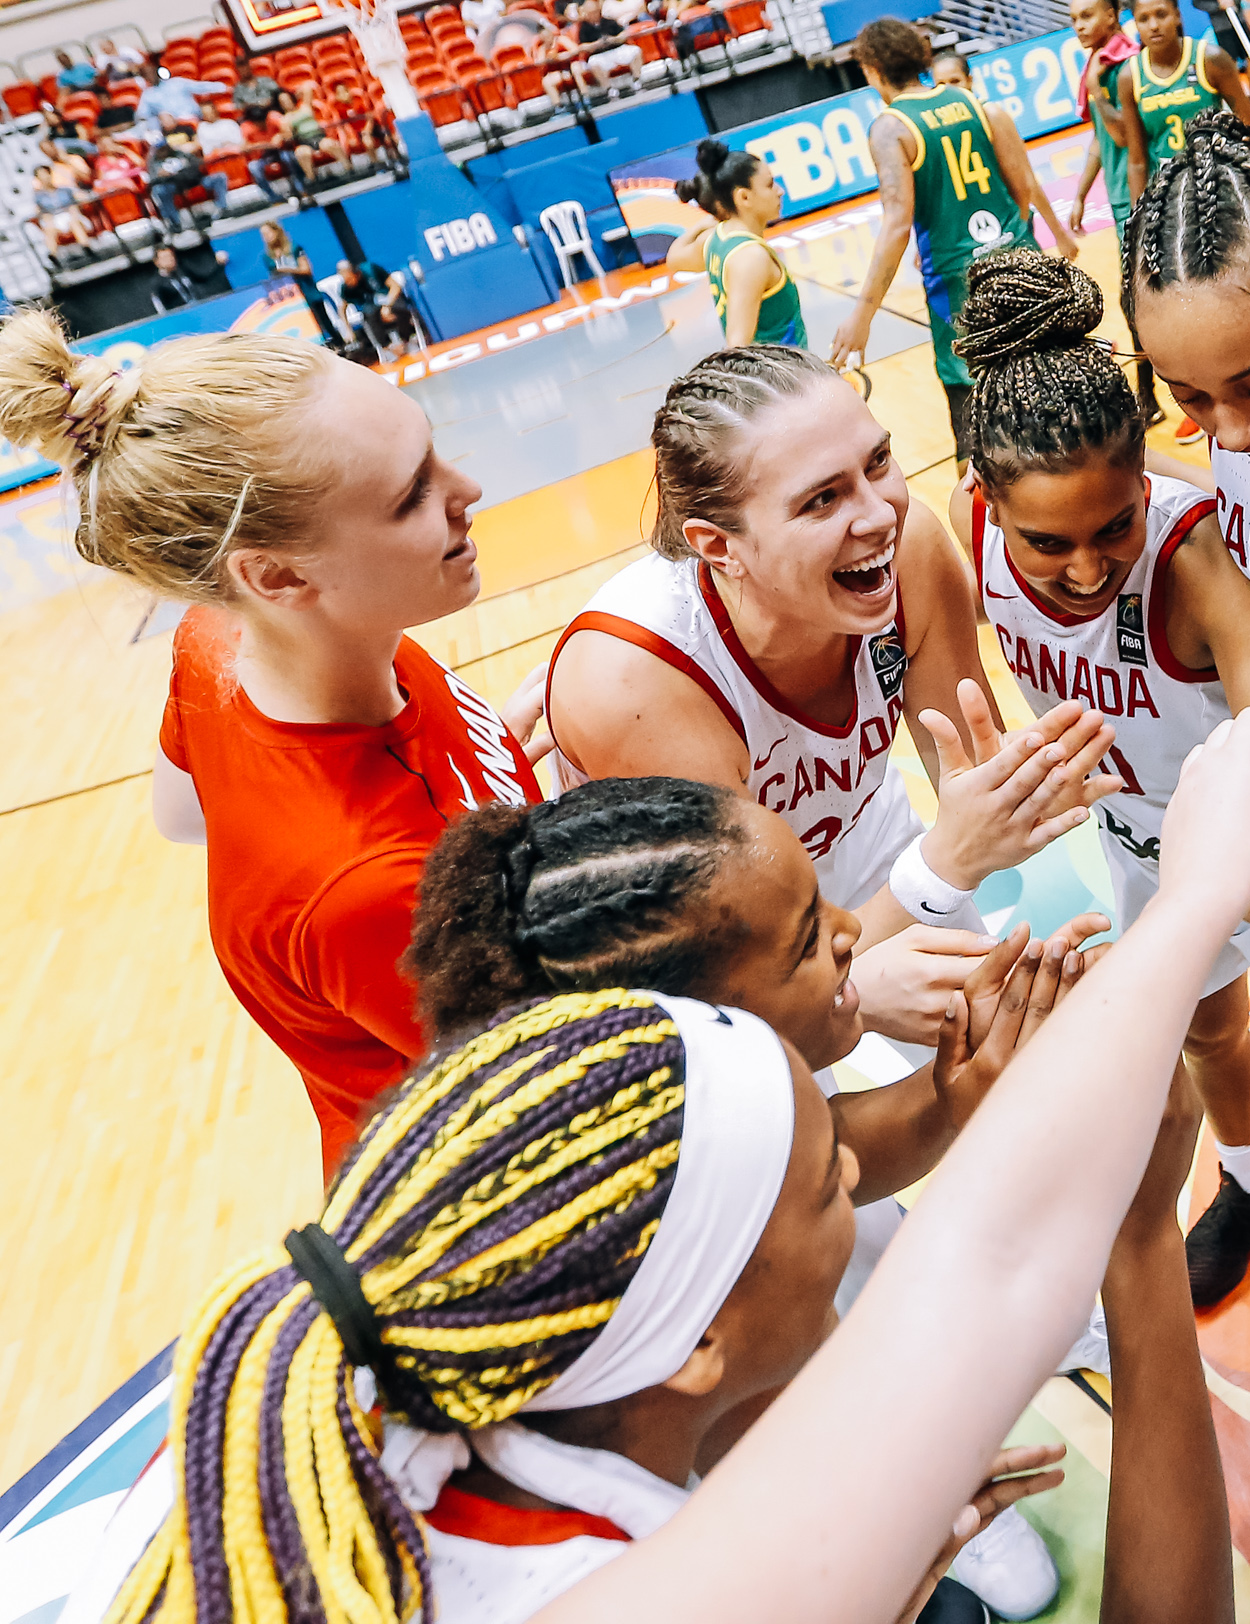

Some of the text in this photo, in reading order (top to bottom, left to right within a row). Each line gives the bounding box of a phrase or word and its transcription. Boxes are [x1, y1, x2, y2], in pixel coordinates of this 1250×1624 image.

[1165, 114, 1185, 150] 3
[940, 130, 991, 201] 14
[424, 212, 498, 262] FIBA
[1121, 634, 1142, 650] FIBA
[996, 622, 1161, 719] CANADA
